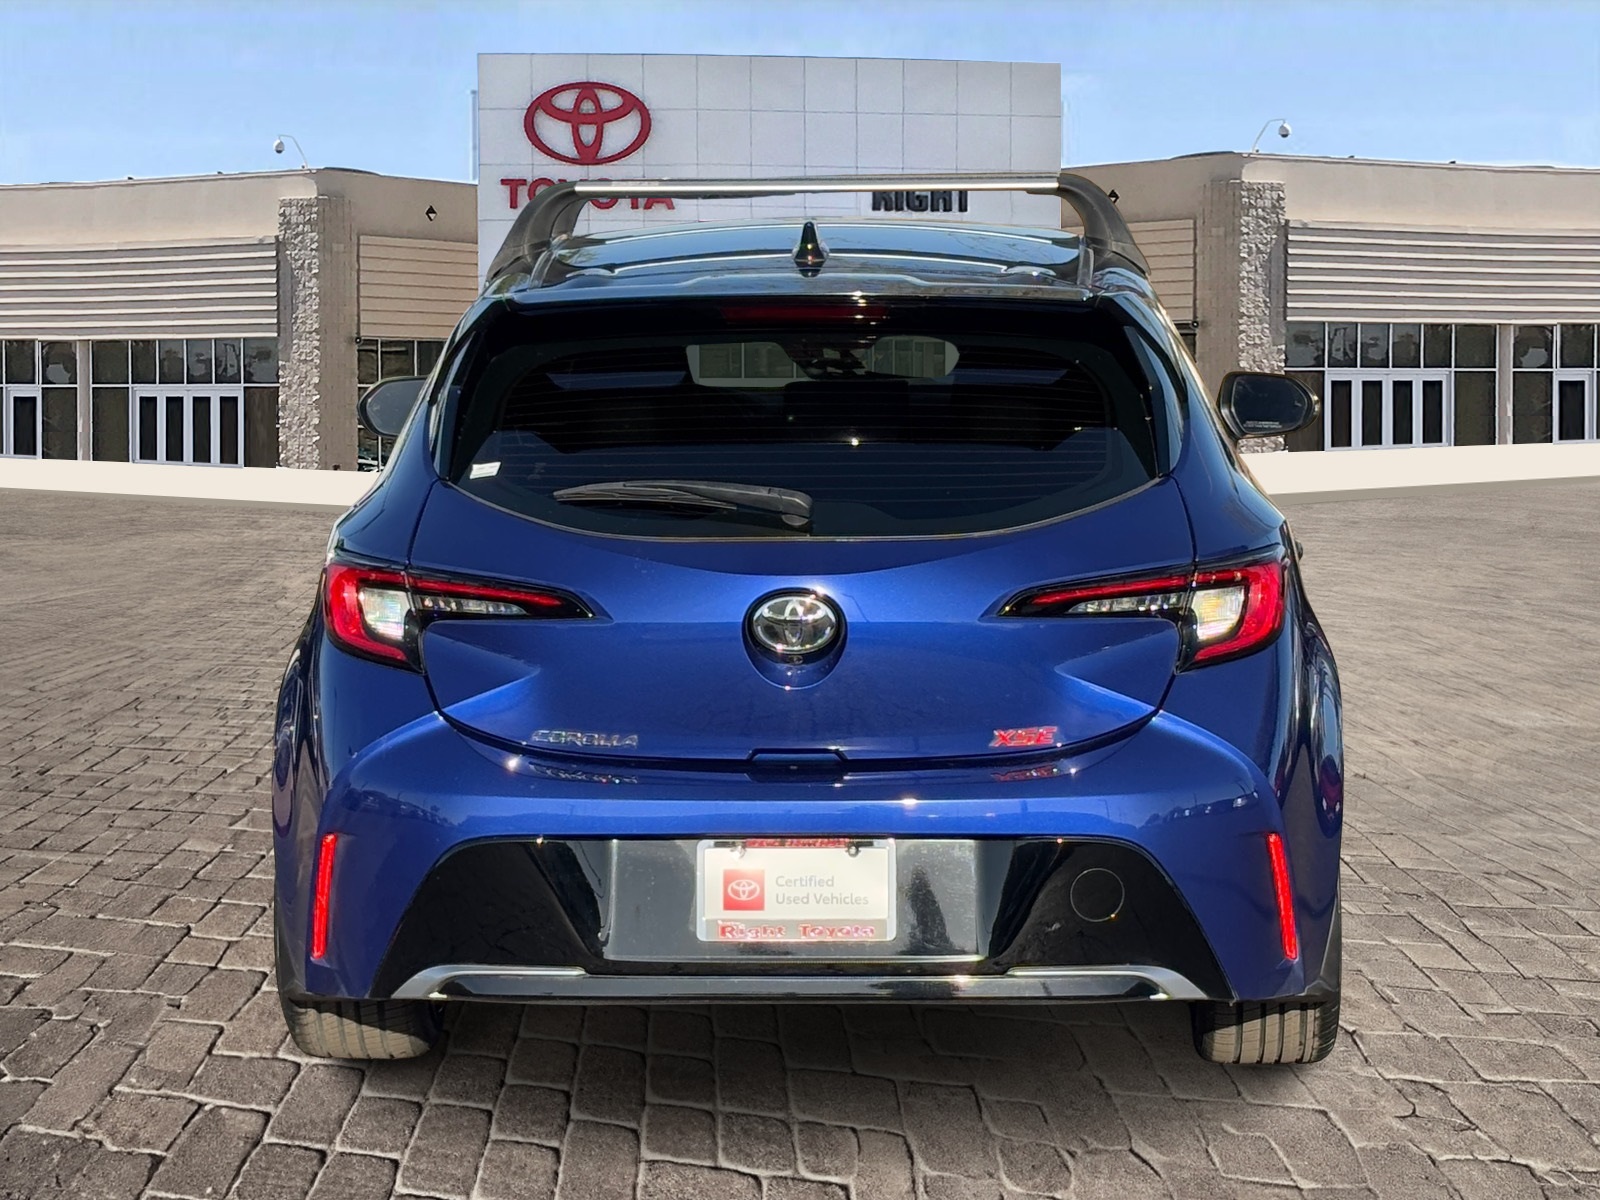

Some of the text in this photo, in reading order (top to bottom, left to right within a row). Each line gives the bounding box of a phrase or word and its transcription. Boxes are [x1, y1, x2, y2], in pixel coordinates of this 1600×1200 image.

[532, 729, 638, 748] COROLLA
[989, 725, 1057, 748] XSE
[775, 875, 835, 888] Certified
[775, 892, 869, 905] Used Vehicles
[718, 923, 876, 939] Right Toyota
